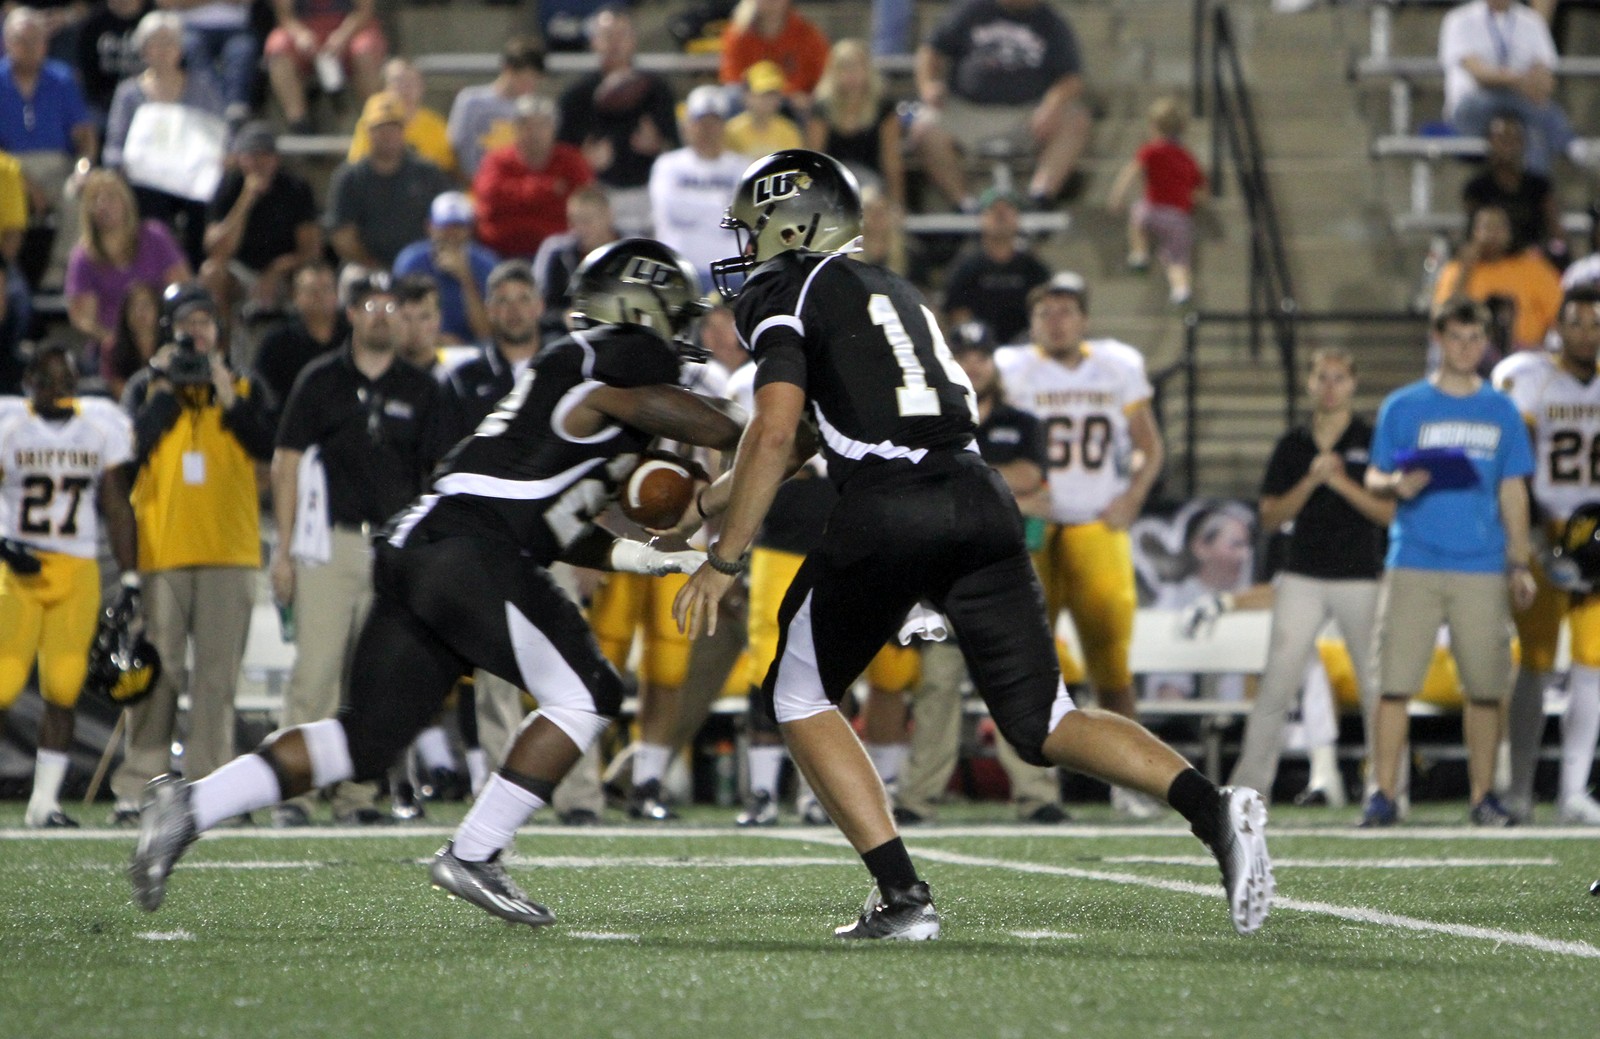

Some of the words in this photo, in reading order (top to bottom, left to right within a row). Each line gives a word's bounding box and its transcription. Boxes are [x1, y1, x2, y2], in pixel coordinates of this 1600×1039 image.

[753, 169, 799, 207] LU
[1044, 412, 1113, 471] 60
[20, 474, 91, 535] 27
